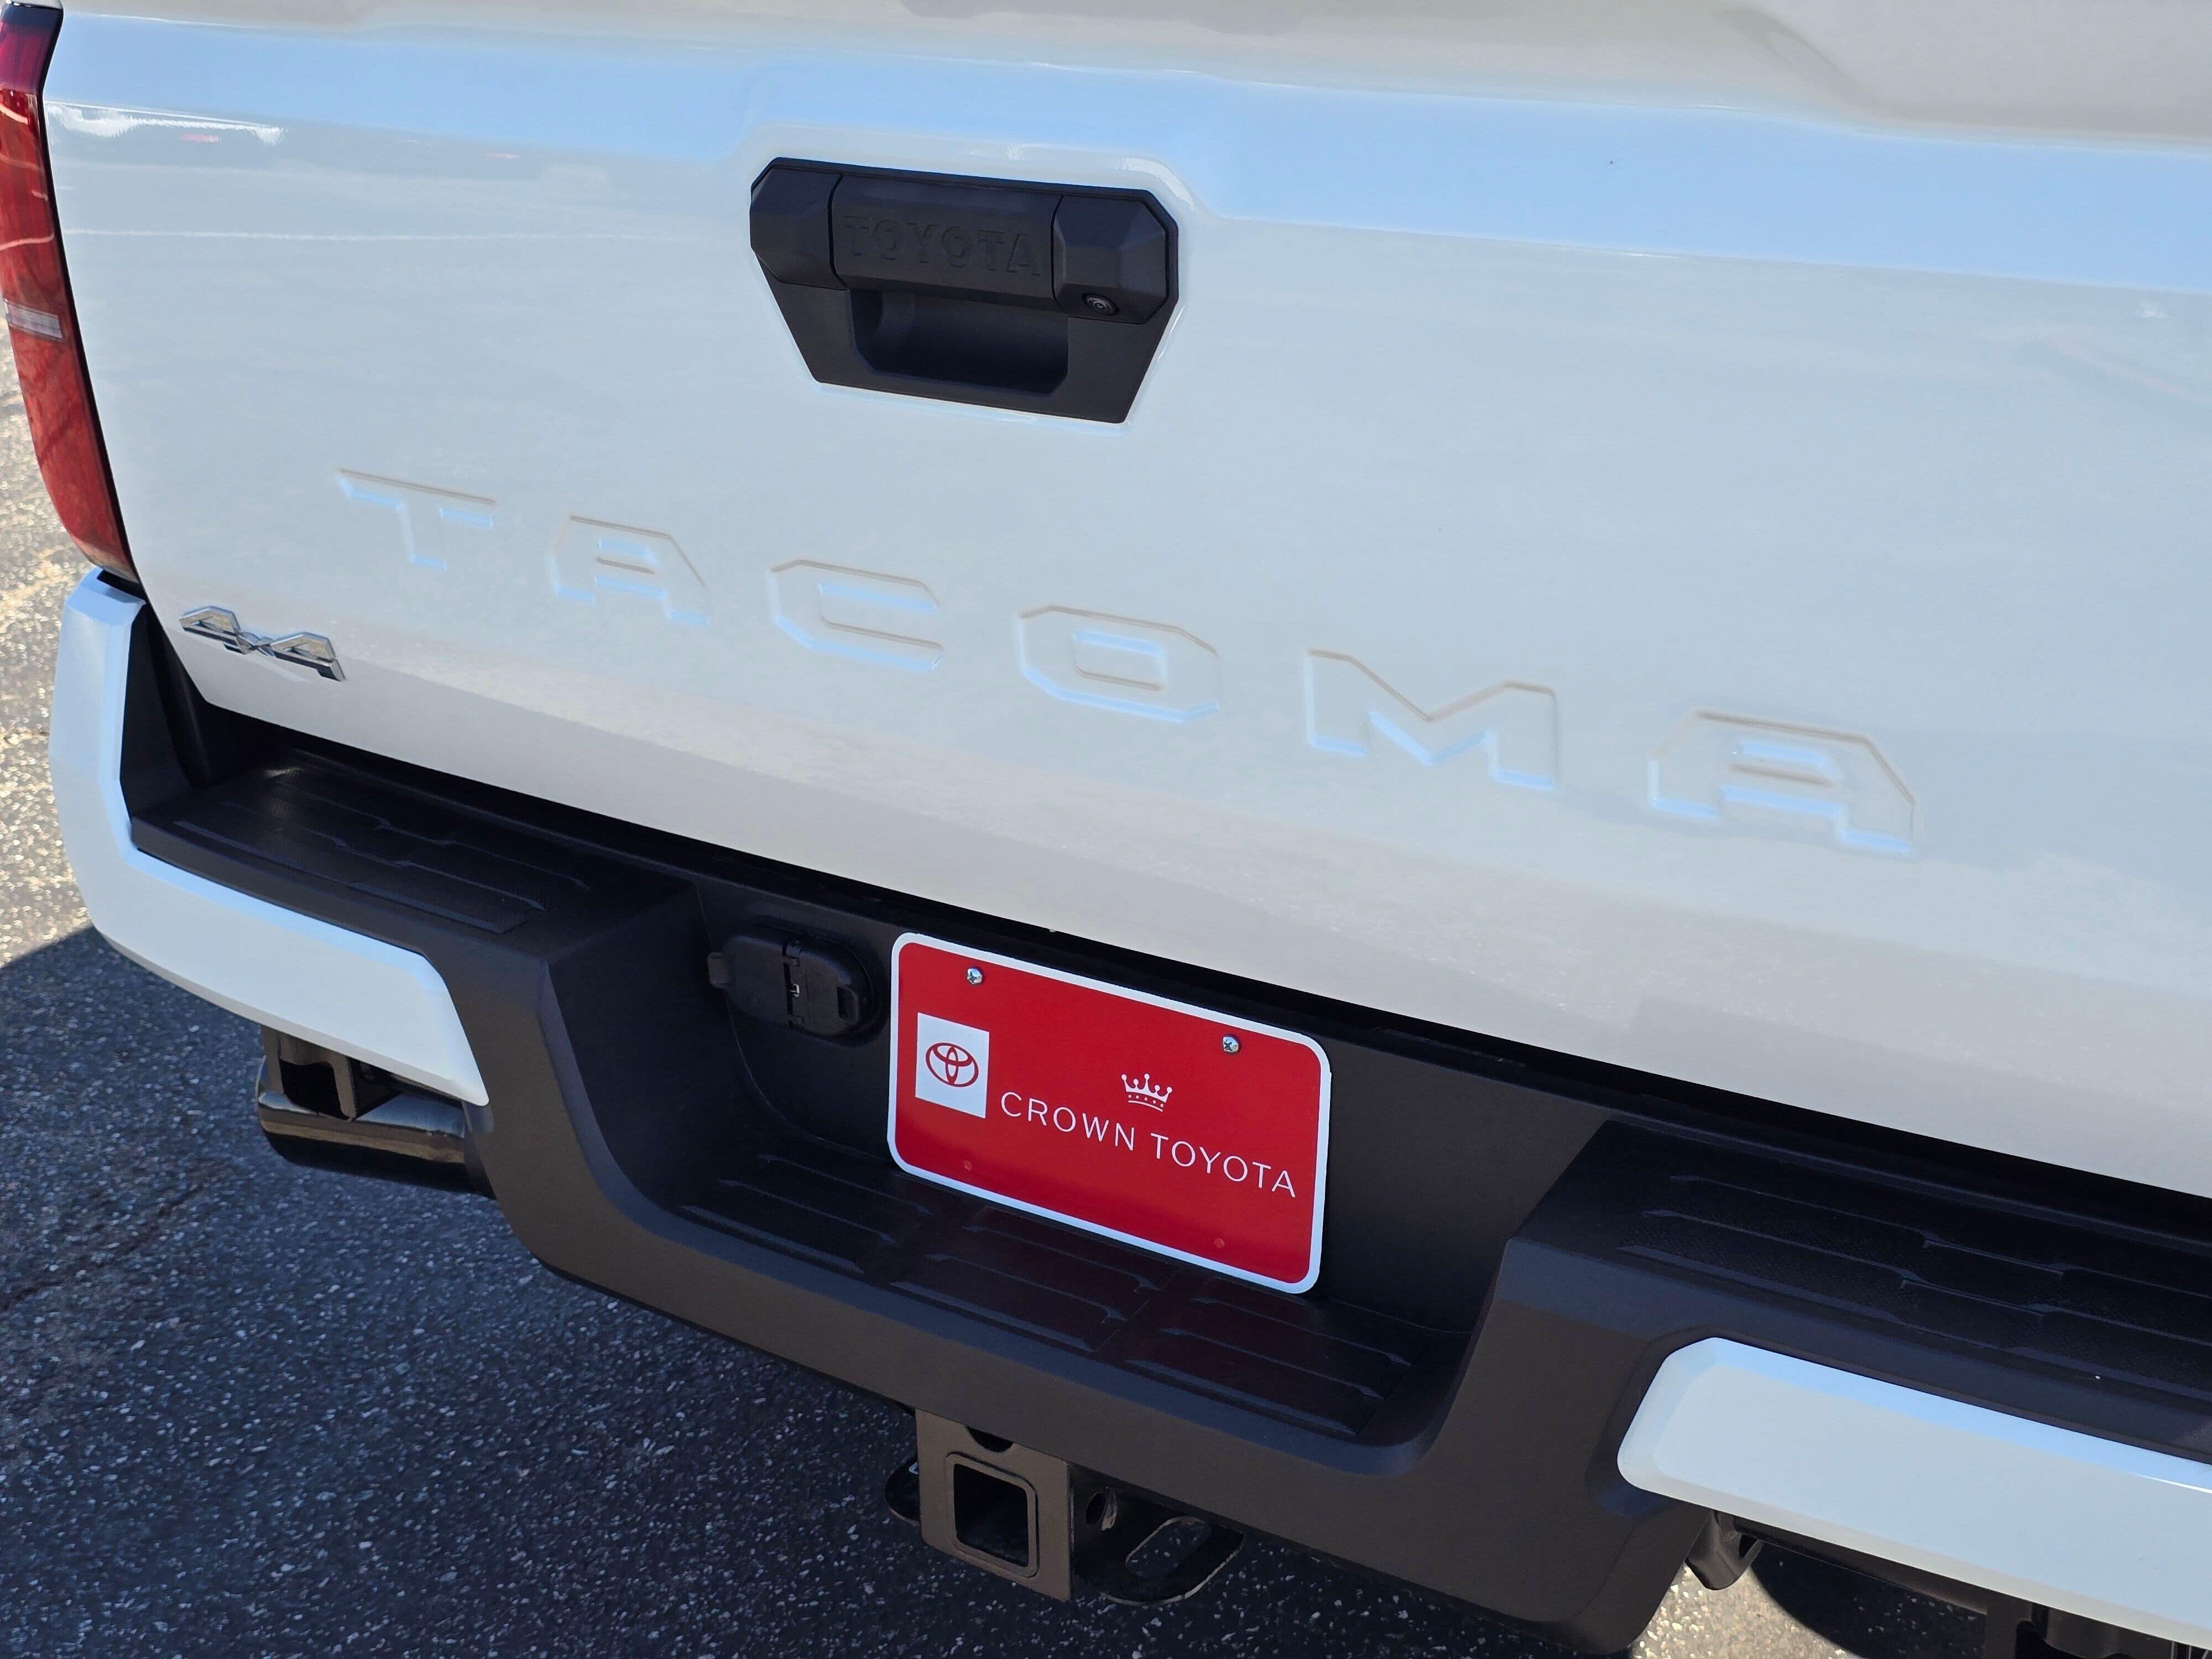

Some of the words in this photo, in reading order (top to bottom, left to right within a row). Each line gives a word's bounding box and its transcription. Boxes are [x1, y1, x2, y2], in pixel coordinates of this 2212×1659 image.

[843, 215, 1042, 277] TOYOTA
[337, 469, 1916, 856] TACOMA
[1001, 1092, 1134, 1151] CROWN
[1151, 1133, 1295, 1198] TOYOTA
